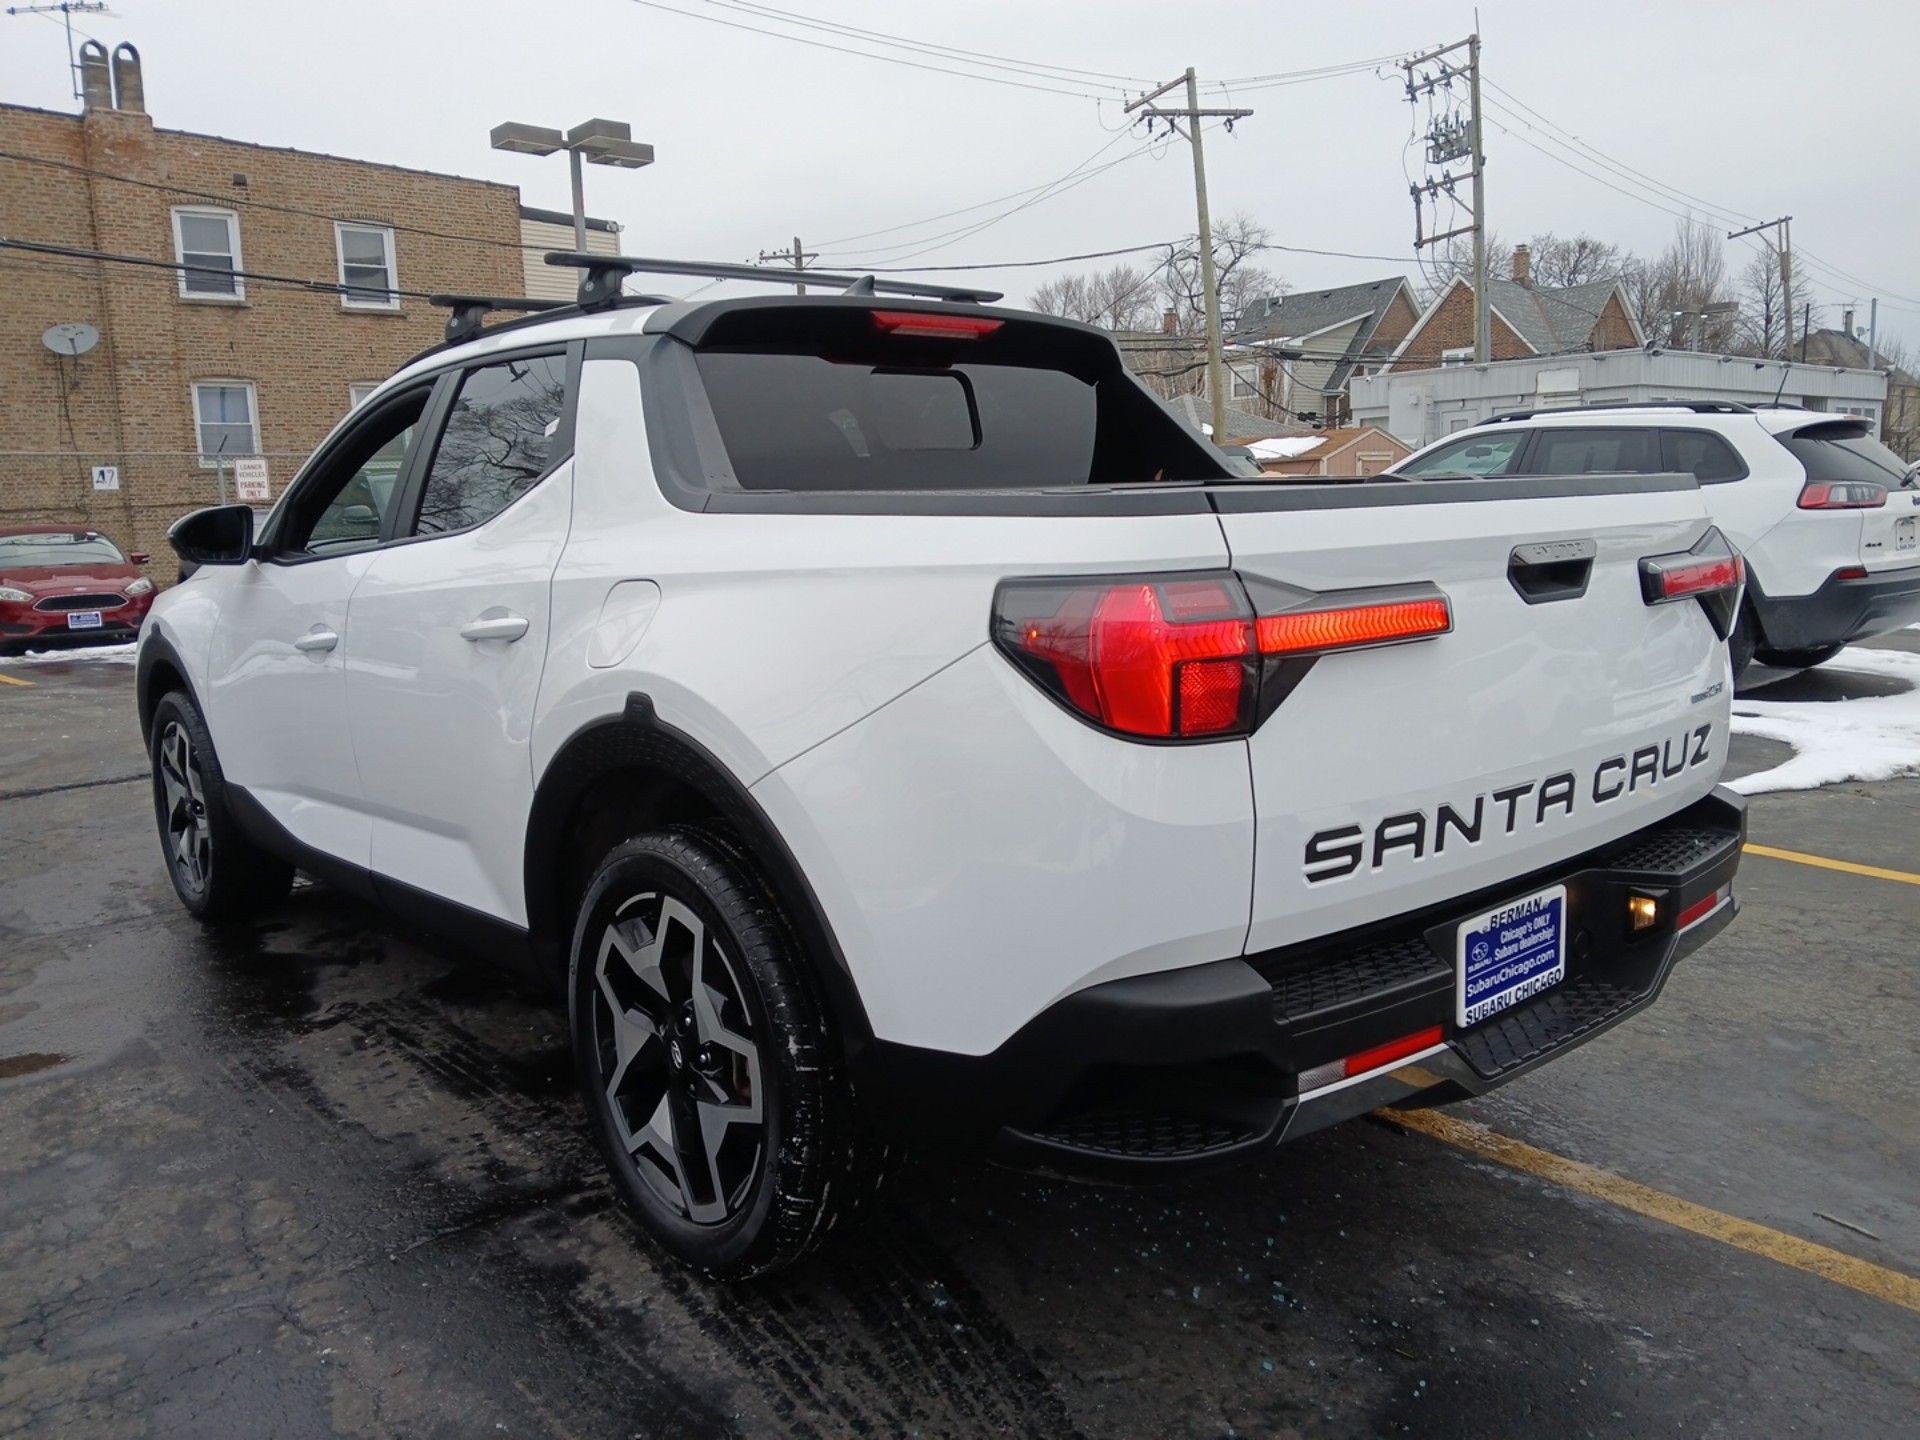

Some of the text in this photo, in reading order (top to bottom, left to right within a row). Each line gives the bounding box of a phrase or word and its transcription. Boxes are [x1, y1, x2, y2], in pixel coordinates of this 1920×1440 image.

[240, 481, 266, 489] PARKING
[245, 490, 262, 498] ONLY
[1303, 723, 1712, 886] SANTA CRUZ
[1488, 897, 1543, 930] BERMAN
[1500, 912, 1551, 944] Chicago's ONLY
[1494, 925, 1555, 962] Subaru dealership!
[1467, 949, 1555, 998] SubaruChicago.com
[1465, 968, 1562, 1026] SUBARU CHICAGO
